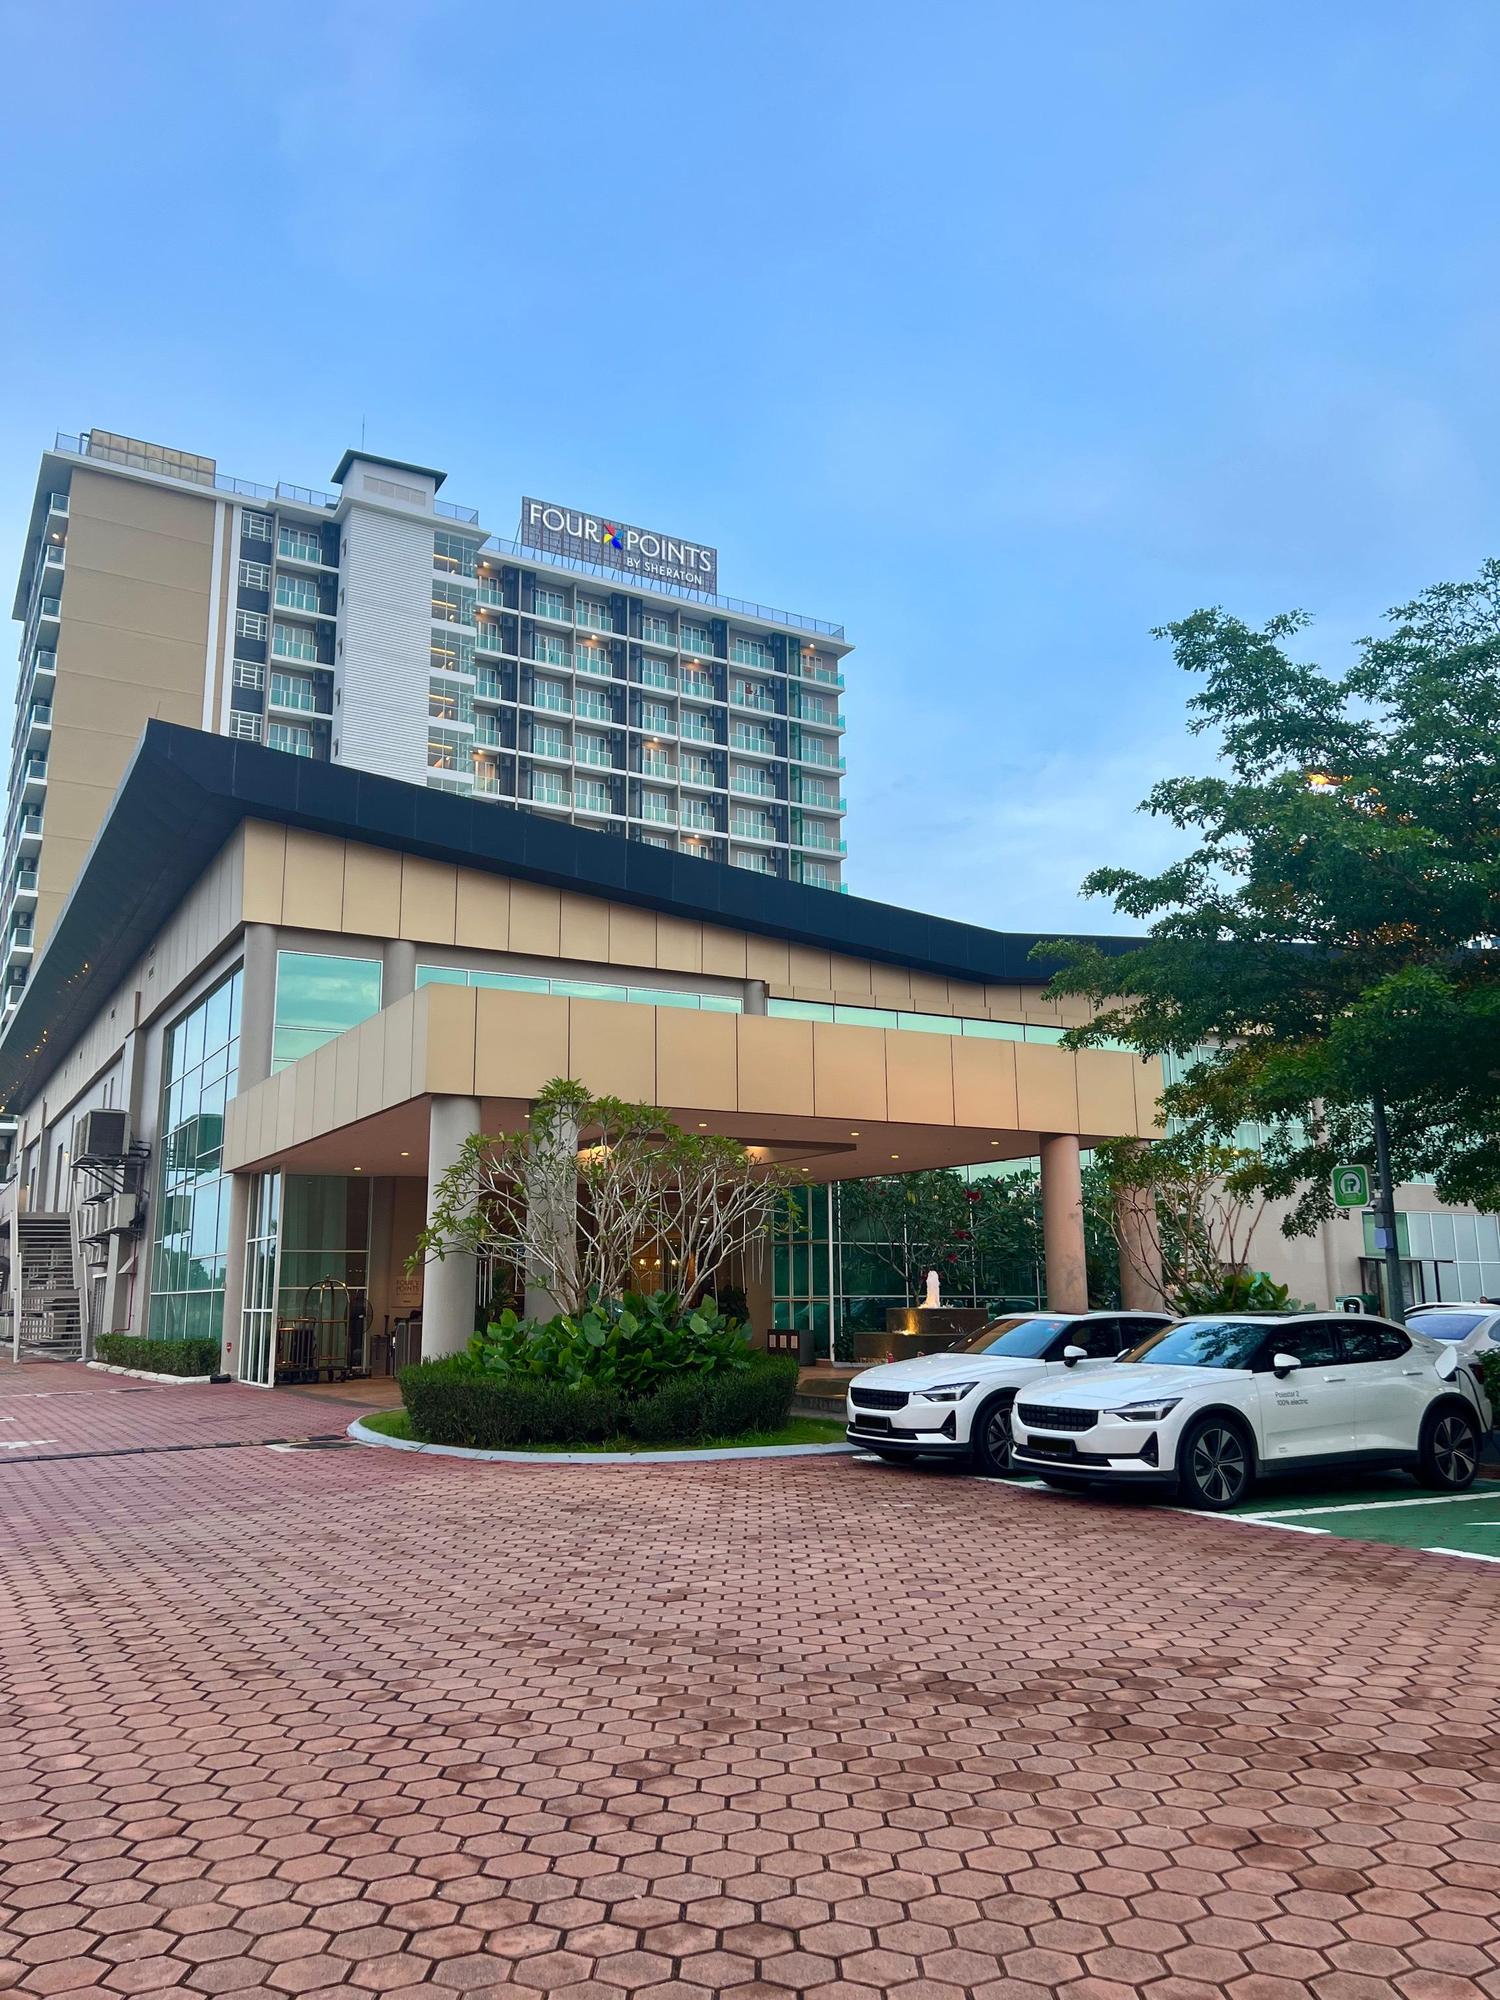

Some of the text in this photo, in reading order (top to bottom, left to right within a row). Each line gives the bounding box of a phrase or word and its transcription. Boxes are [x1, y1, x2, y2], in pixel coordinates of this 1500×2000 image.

[530, 503, 711, 572] FOUR POINTS
[626, 556, 702, 585] BY SHERATON
